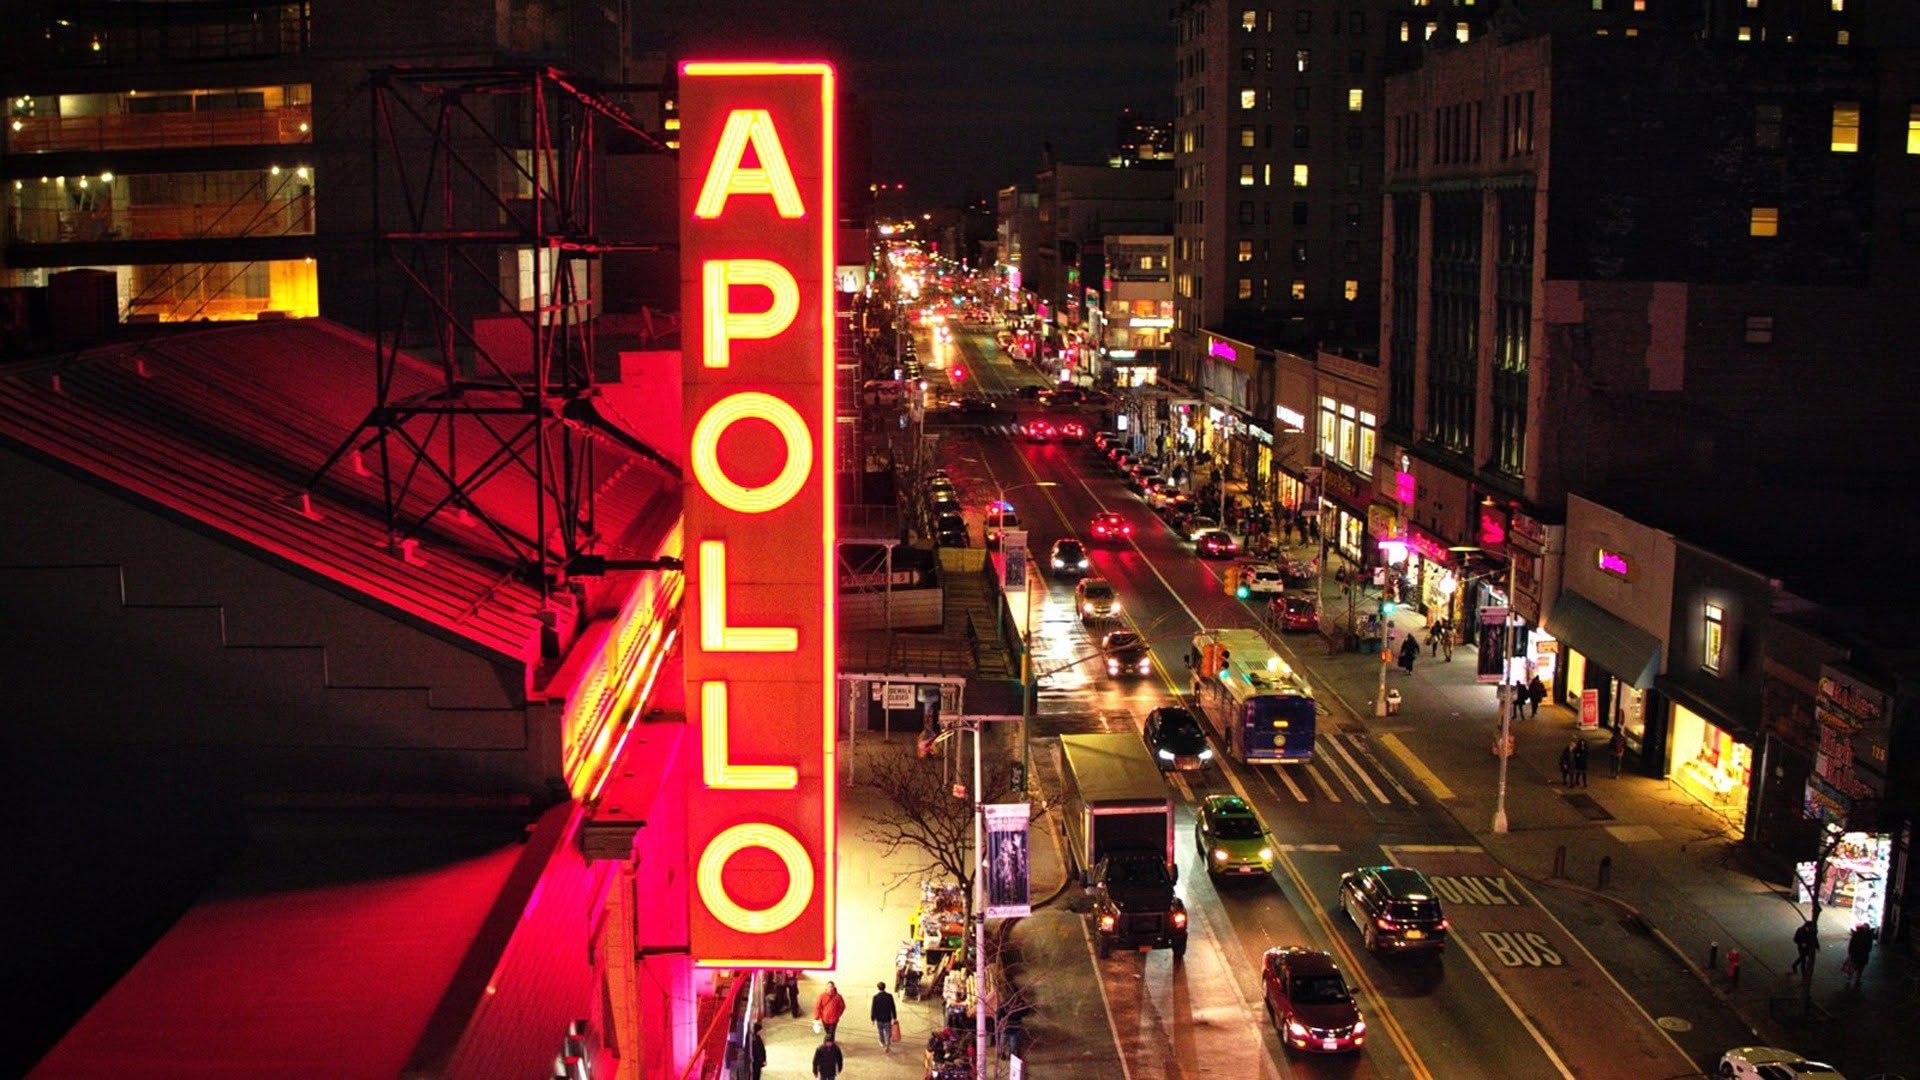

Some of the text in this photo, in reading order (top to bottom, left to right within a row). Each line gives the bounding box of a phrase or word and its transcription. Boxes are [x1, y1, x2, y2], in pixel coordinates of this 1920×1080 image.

[691, 109, 814, 934] APOLLO
[1430, 876, 1520, 905] ONLY
[1480, 932, 1562, 967] BUS
